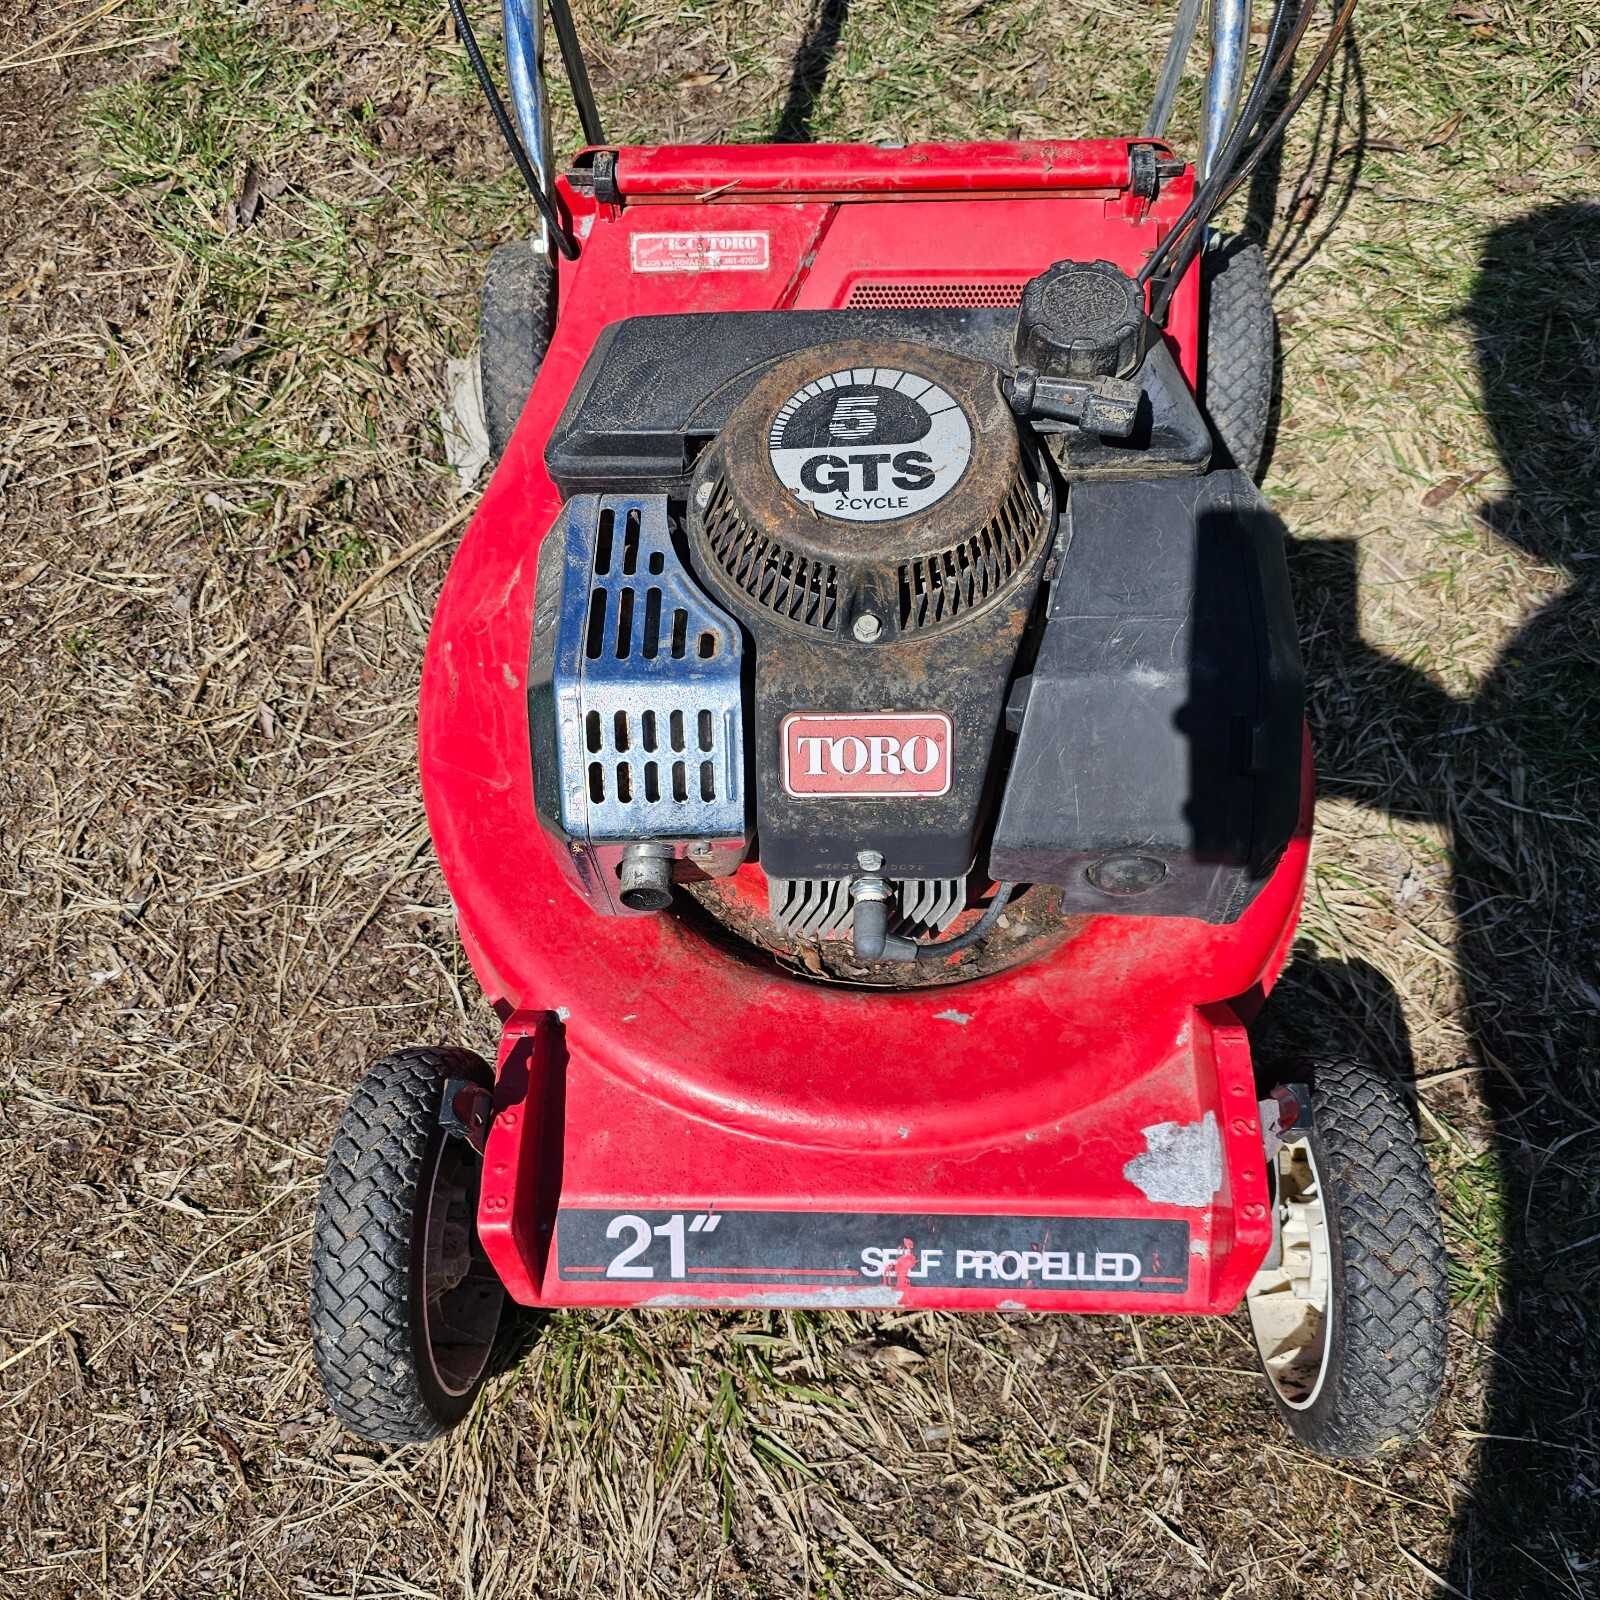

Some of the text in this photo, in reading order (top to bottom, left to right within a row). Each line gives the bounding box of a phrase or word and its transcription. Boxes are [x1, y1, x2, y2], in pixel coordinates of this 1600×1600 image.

[708, 237, 758, 250] TORO
[829, 396, 880, 440] 5
[800, 451, 936, 494] GTS
[835, 496, 909, 510] 2-CYCLE
[797, 735, 941, 775] TORO
[956, 1250, 1142, 1282] PROPELLED
